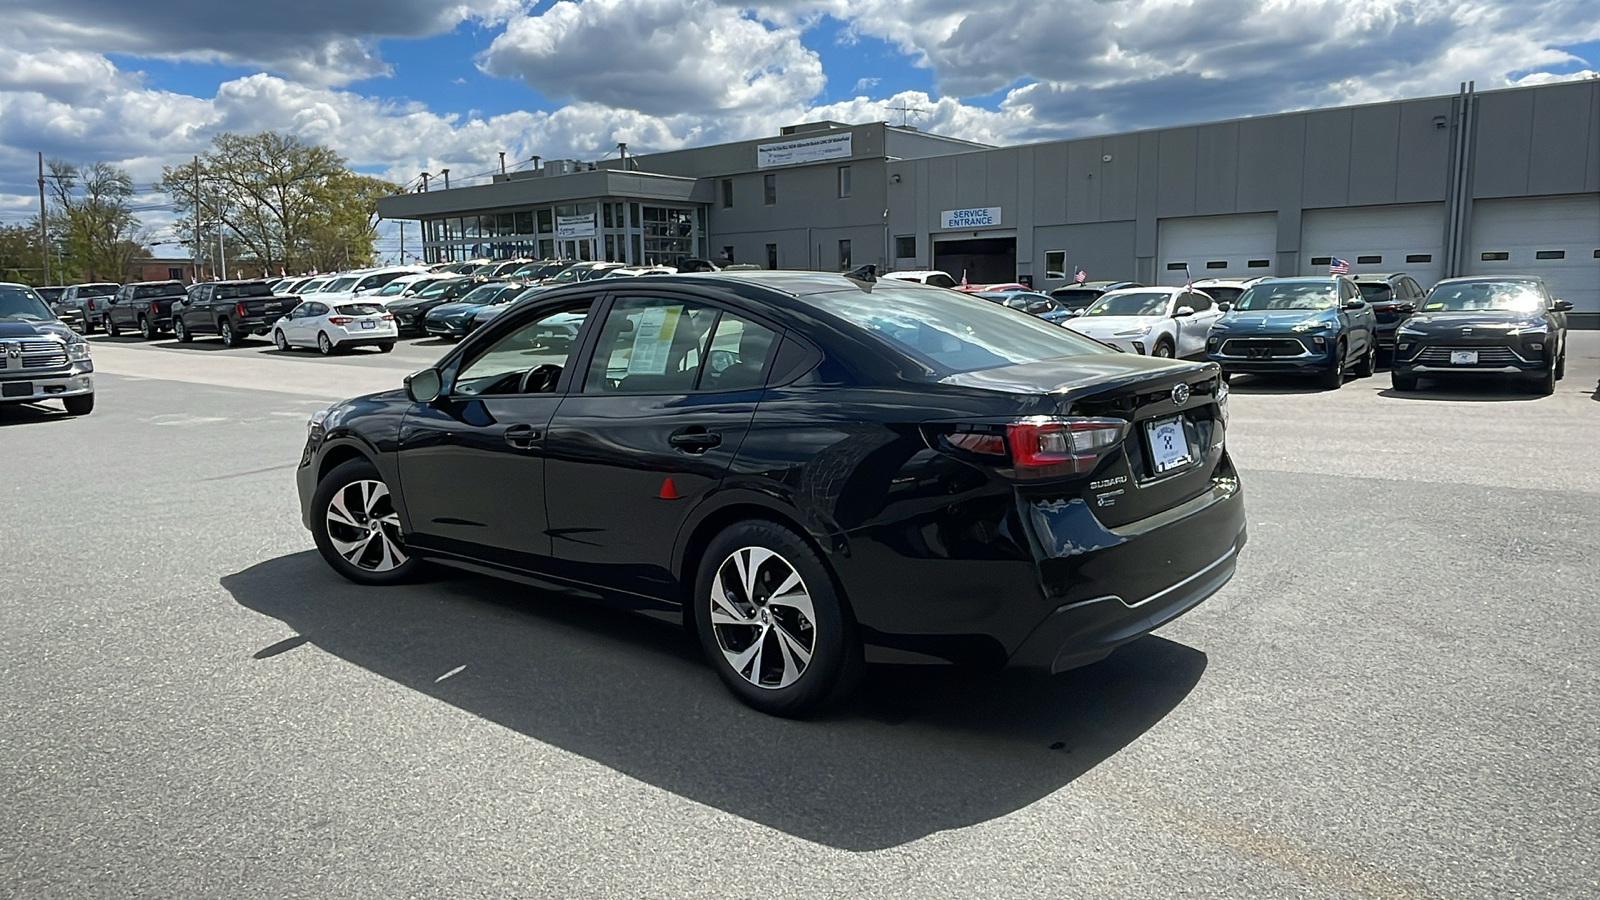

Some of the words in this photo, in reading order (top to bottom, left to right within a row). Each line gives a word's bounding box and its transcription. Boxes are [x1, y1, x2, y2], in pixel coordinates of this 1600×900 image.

[954, 209, 988, 218] SERVICE
[949, 217, 992, 227] ENTRANCE
[1090, 475, 1128, 489] SUBARU
